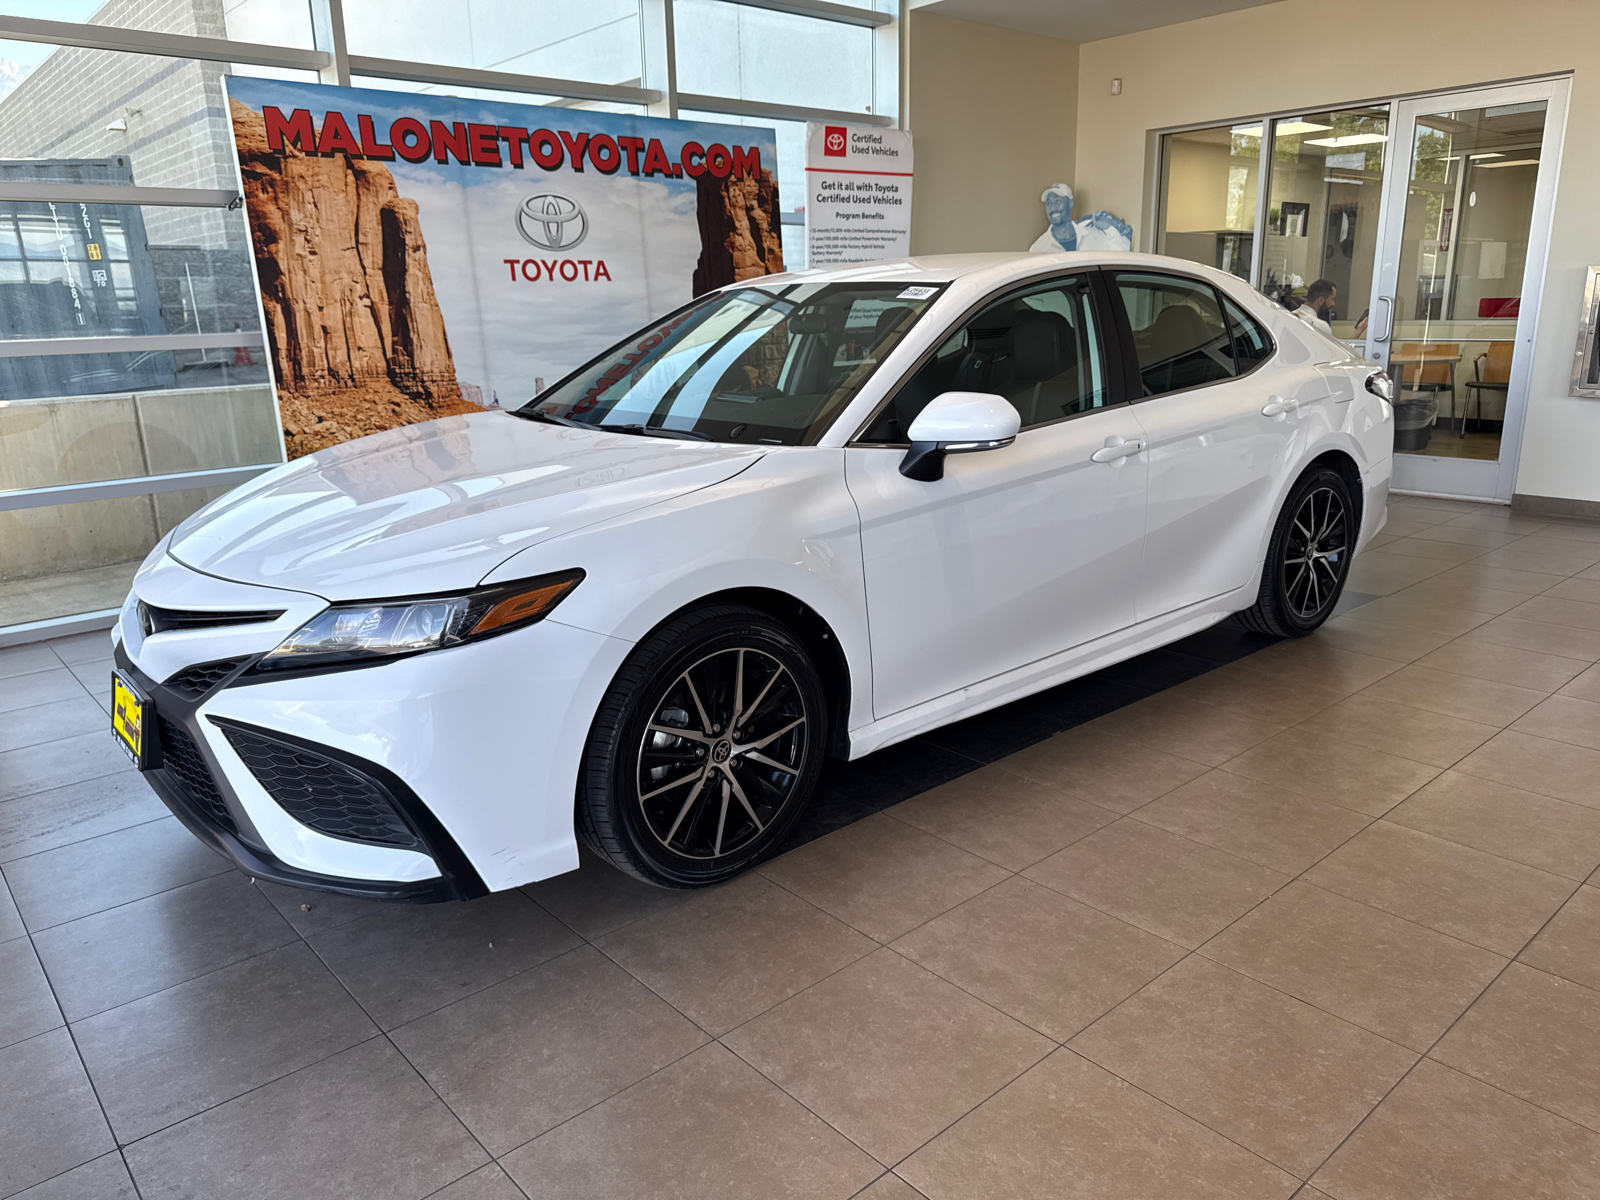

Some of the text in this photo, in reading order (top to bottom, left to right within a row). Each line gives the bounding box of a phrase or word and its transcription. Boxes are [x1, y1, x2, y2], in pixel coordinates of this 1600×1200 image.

[262, 105, 761, 183] MALONETOYOTA.COM
[851, 133, 882, 144] Certified
[851, 145, 899, 157] Used Vehicles
[821, 181, 899, 194] Get it all with Toyota
[816, 193, 902, 206] Certified Used Vehicles
[80, 203, 92, 239] 2G1
[835, 211, 885, 221] Program Benefits
[503, 258, 612, 282] TOYOTA
